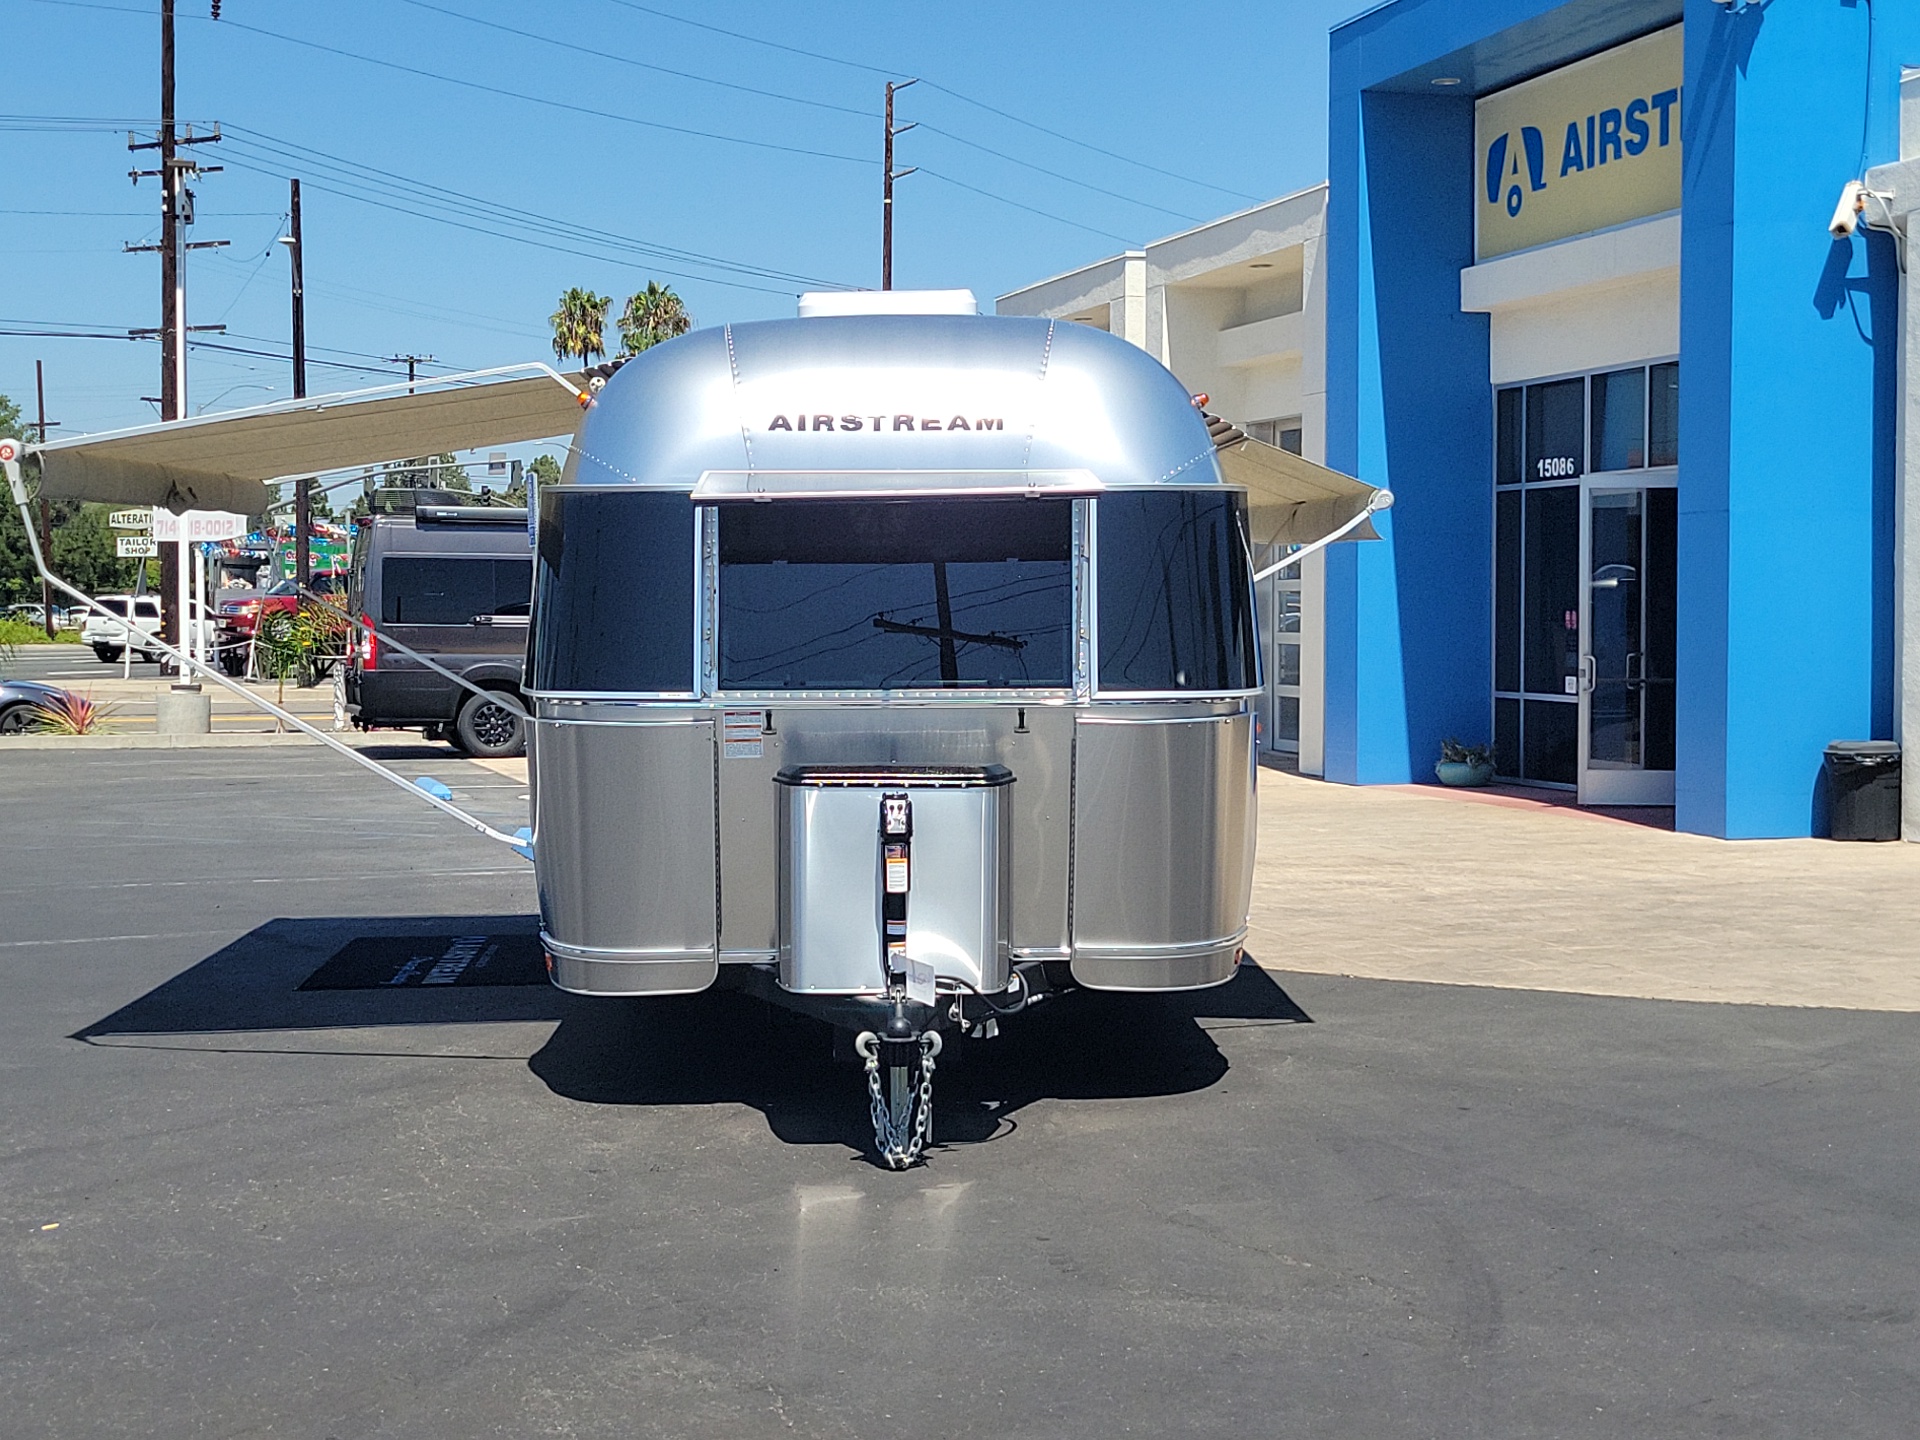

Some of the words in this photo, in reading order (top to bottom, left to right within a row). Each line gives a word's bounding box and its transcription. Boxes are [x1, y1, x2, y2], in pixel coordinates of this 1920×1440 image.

[1559, 85, 1683, 178] AIRST
[768, 414, 1004, 432] AIRSTREAM
[1537, 457, 1575, 478] 15086
[110, 513, 154, 524] ALTERATI
[119, 538, 157, 546] TAILOR
[125, 547, 151, 555] SHOP
